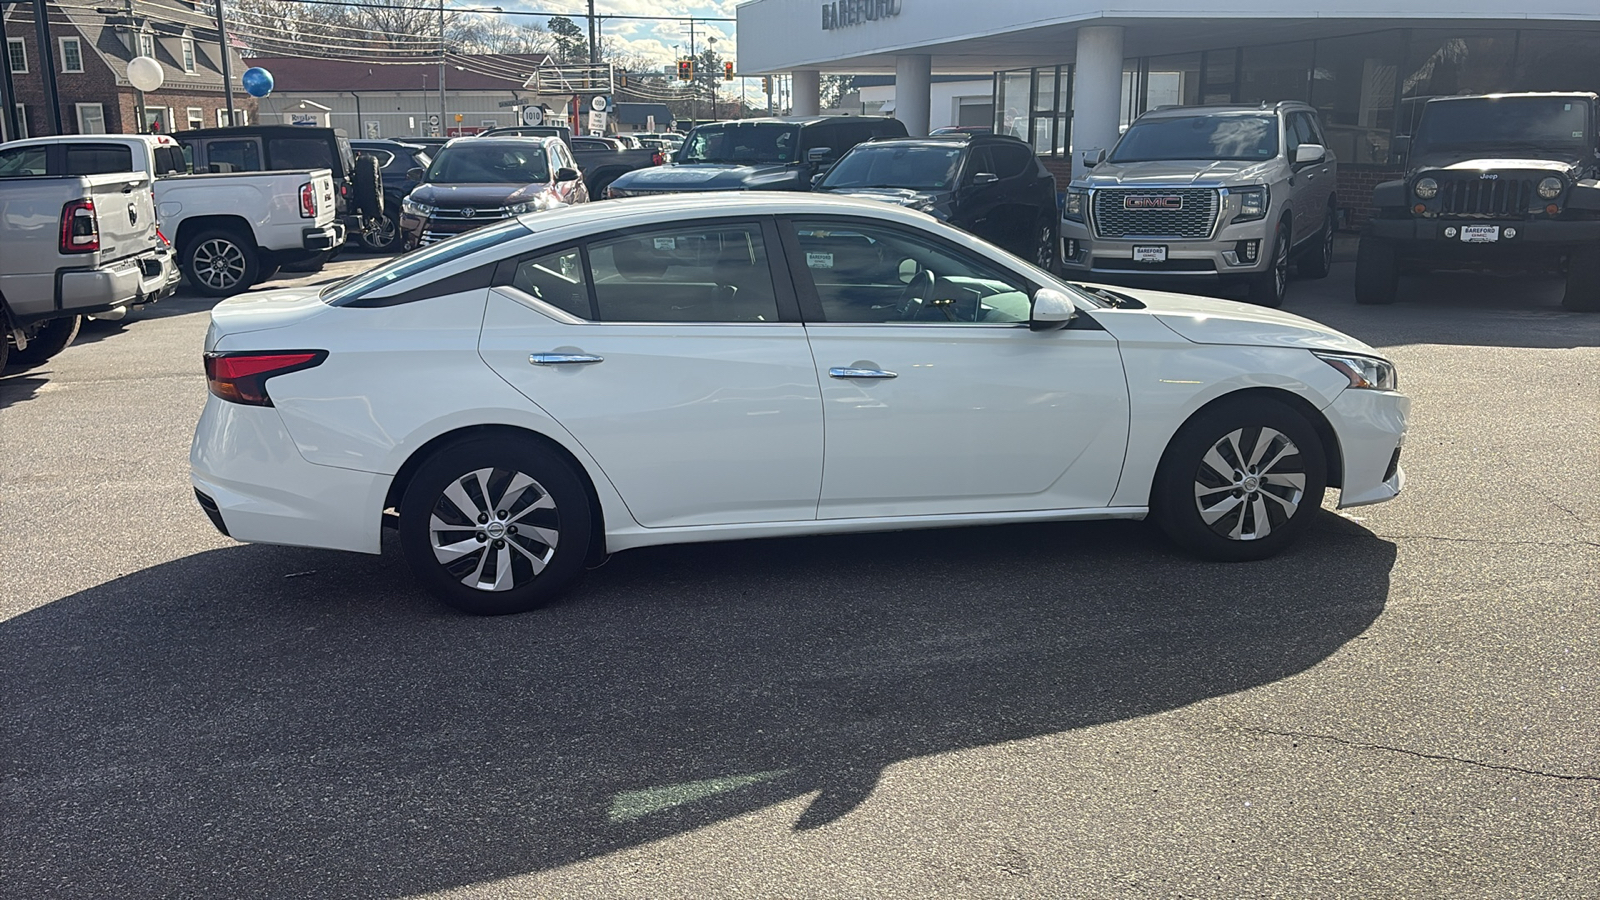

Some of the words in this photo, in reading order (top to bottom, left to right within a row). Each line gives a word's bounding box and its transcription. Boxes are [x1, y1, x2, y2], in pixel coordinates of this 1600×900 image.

[821, 0, 902, 31] BAREFORD
[525, 111, 541, 120] 1010
[1127, 197, 1180, 207] GMC
